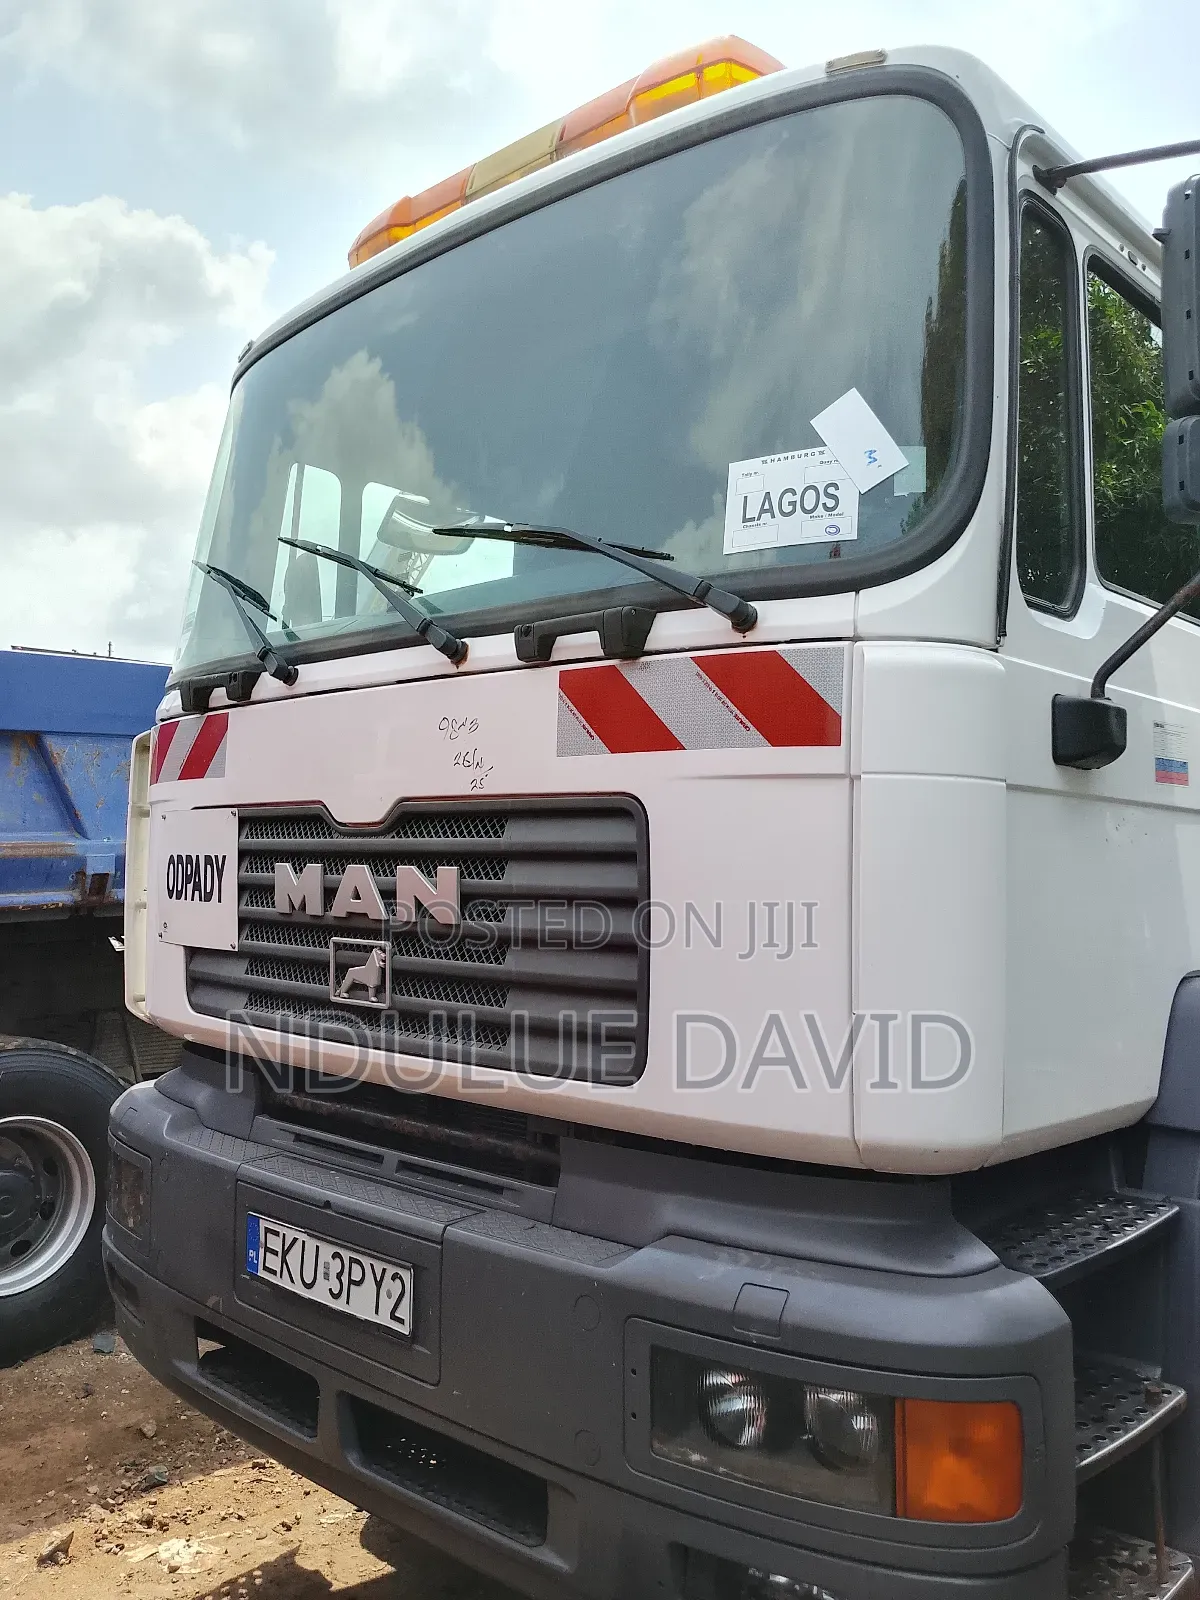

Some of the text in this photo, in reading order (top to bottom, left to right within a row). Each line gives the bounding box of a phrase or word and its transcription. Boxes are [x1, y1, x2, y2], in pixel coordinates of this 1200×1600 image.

[770, 450, 817, 464] HAMBURG
[742, 482, 840, 524] LAGOS
[166, 854, 227, 903] ODPADY
[274, 863, 460, 925] MAN
[248, 1249, 258, 1264] PL
[262, 1225, 406, 1326] EKU 3PY2
